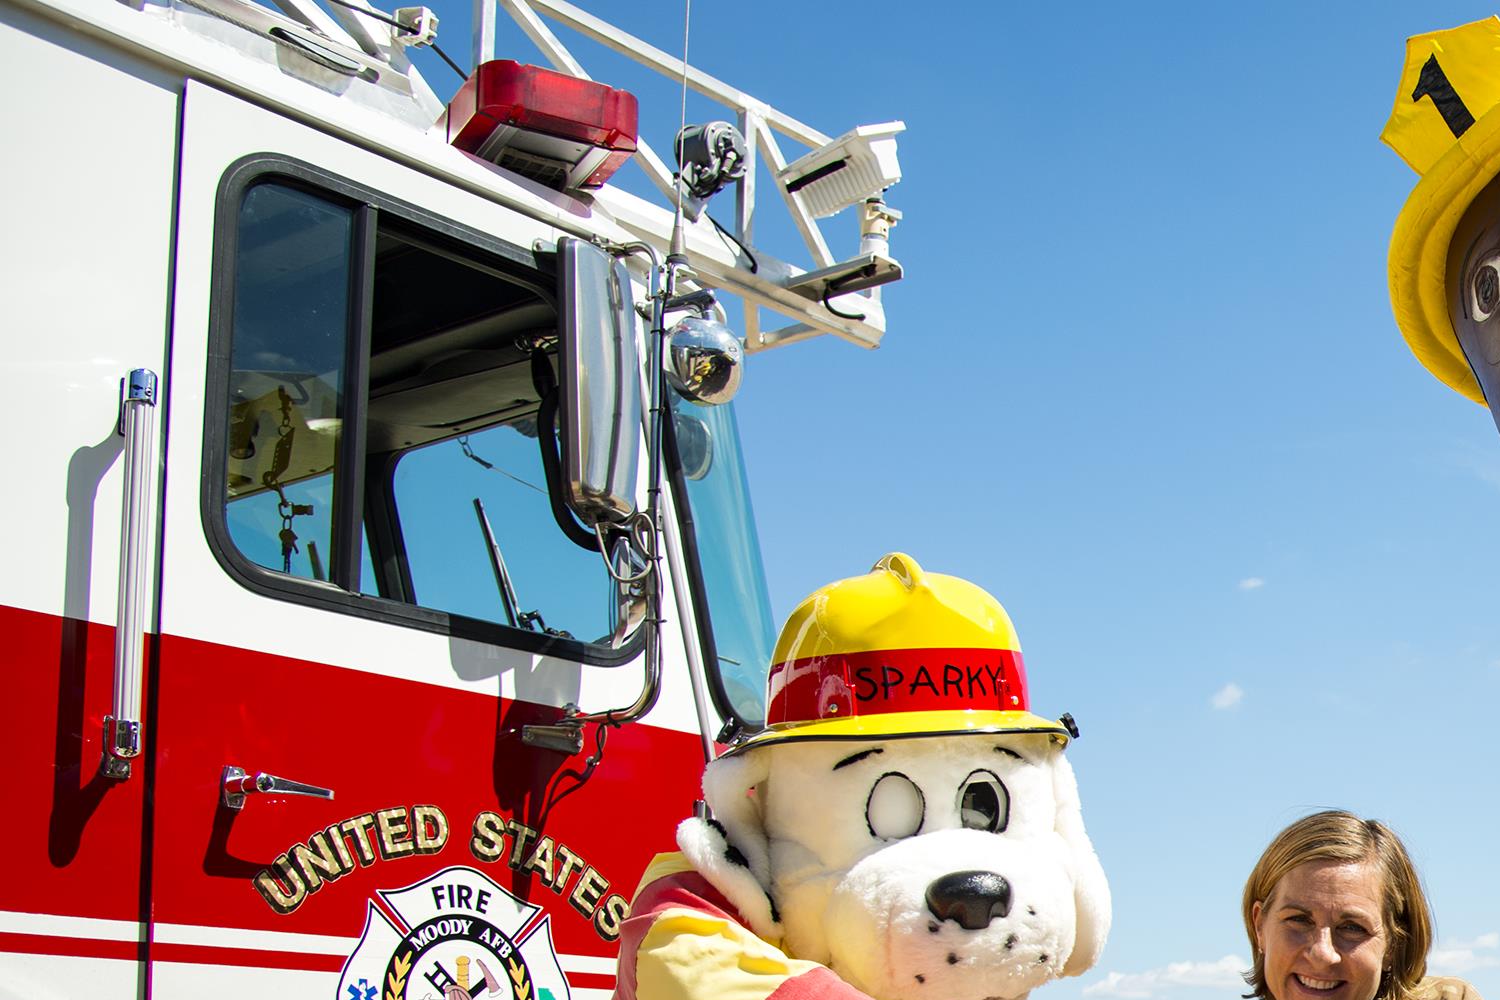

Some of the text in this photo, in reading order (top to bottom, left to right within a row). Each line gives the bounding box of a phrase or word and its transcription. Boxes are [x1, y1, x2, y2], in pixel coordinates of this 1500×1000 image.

[1411, 53, 1476, 139] 1
[855, 663, 1002, 701] SPARKY
[252, 805, 632, 941] UNITED STATES
[432, 884, 492, 914] FIRE
[409, 918, 512, 959] MOODY AFB
